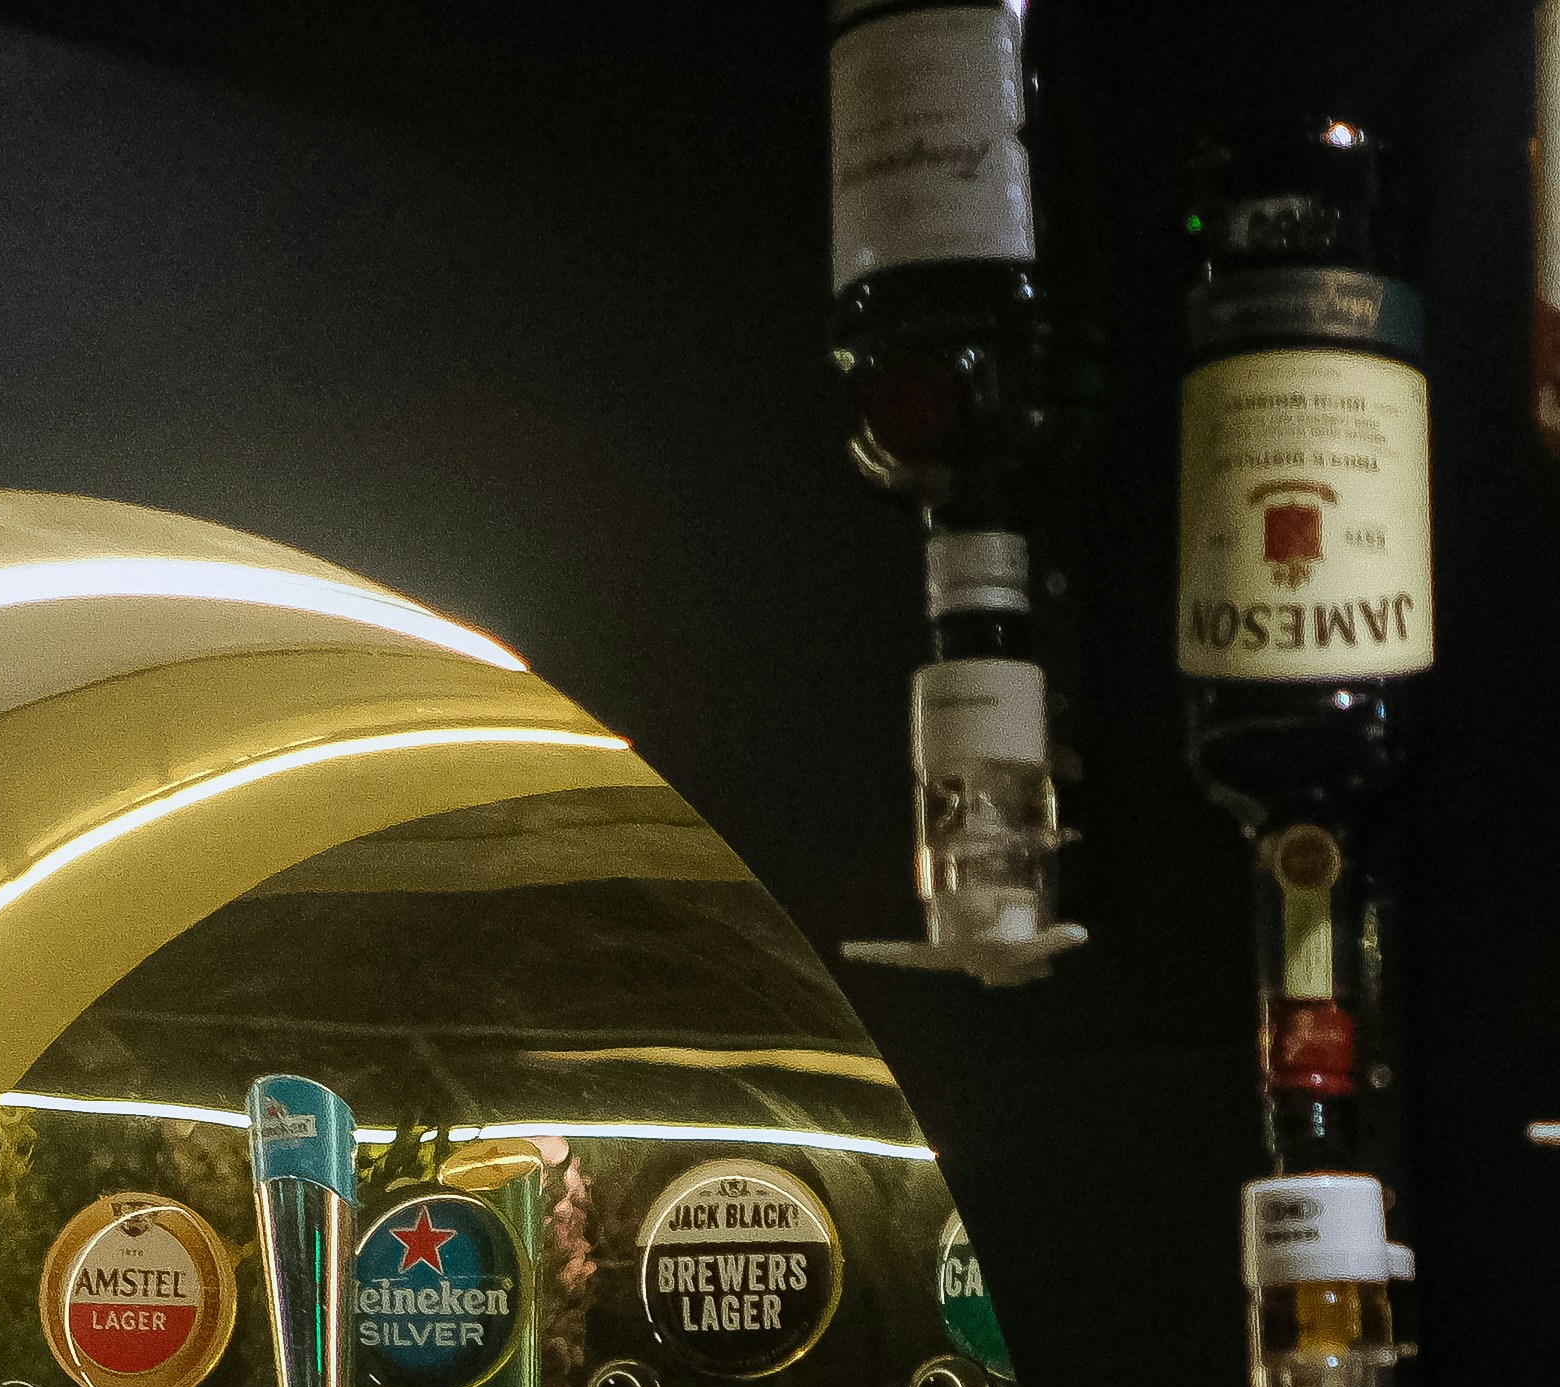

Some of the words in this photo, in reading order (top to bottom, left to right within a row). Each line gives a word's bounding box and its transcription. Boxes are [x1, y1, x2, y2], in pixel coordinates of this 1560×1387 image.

[1189, 593, 1414, 651] JAMESON
[669, 1203, 719, 1231] JACK
[74, 1268, 187, 1299] AMSTEL
[658, 1252, 808, 1293] BREWERS
[354, 1279, 510, 1315] eineken
[682, 1294, 783, 1332] LAGER
[92, 1310, 167, 1331] LAGER
[359, 1321, 485, 1346] SILVER
